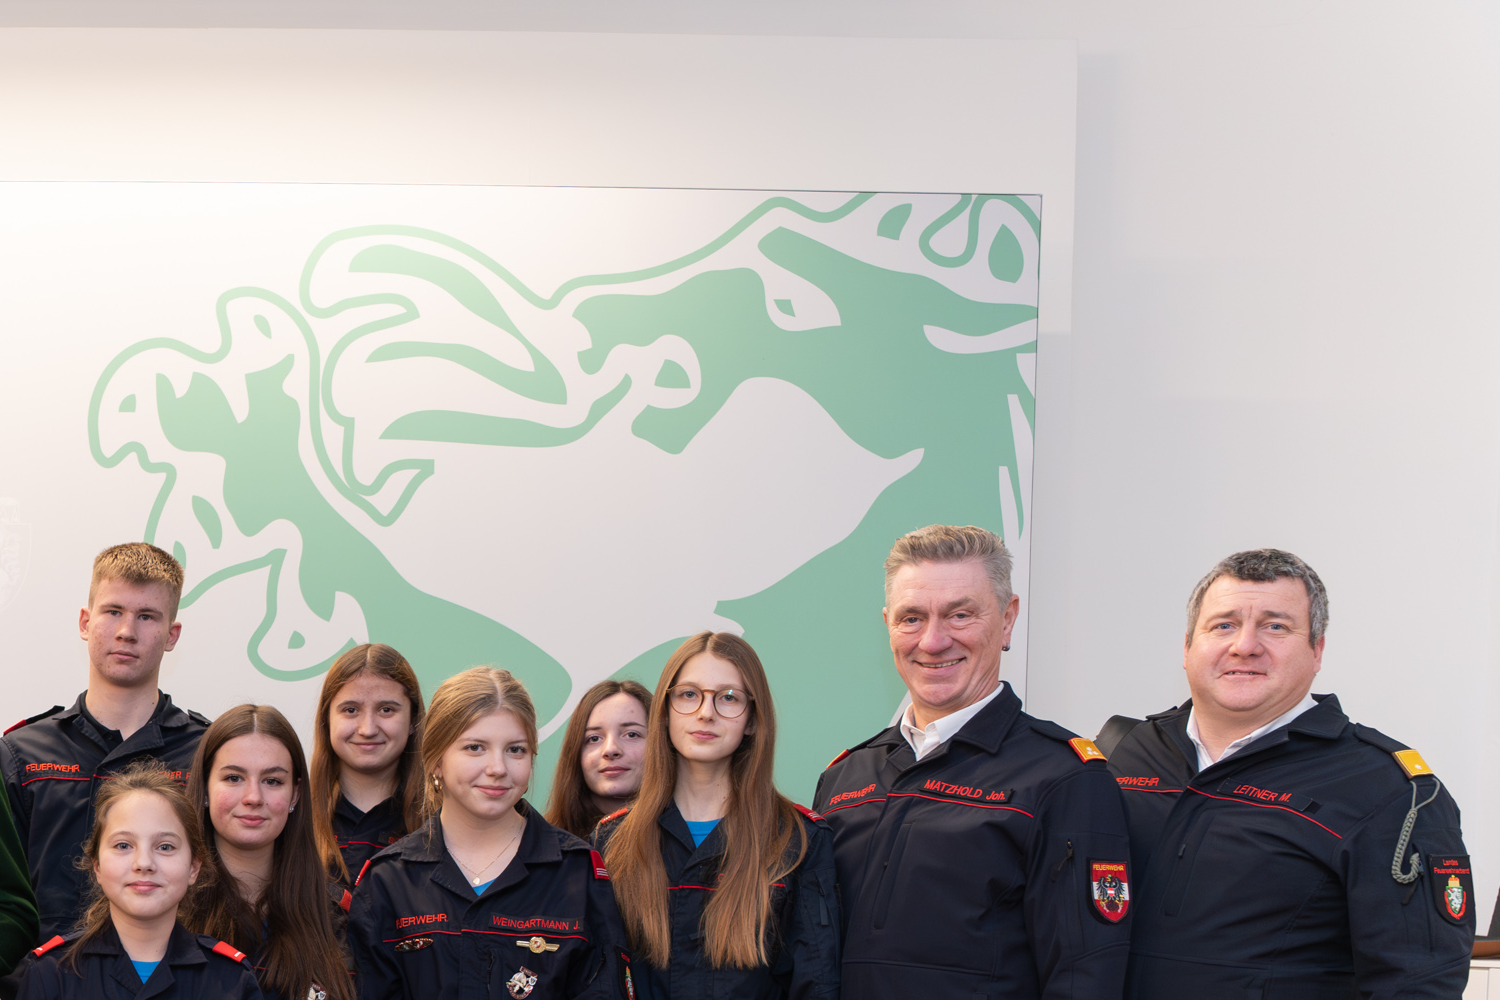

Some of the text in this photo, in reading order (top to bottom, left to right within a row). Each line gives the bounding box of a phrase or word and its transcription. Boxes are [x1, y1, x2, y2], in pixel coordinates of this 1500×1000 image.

[26, 763, 79, 772] FEUERWEHR
[1116, 777, 1159, 786] ERWEHR
[924, 779, 1005, 800] MATZHOLD Joh.
[1233, 785, 1292, 802] LEITNER M.
[493, 916, 569, 930] WEINGARTMANN
